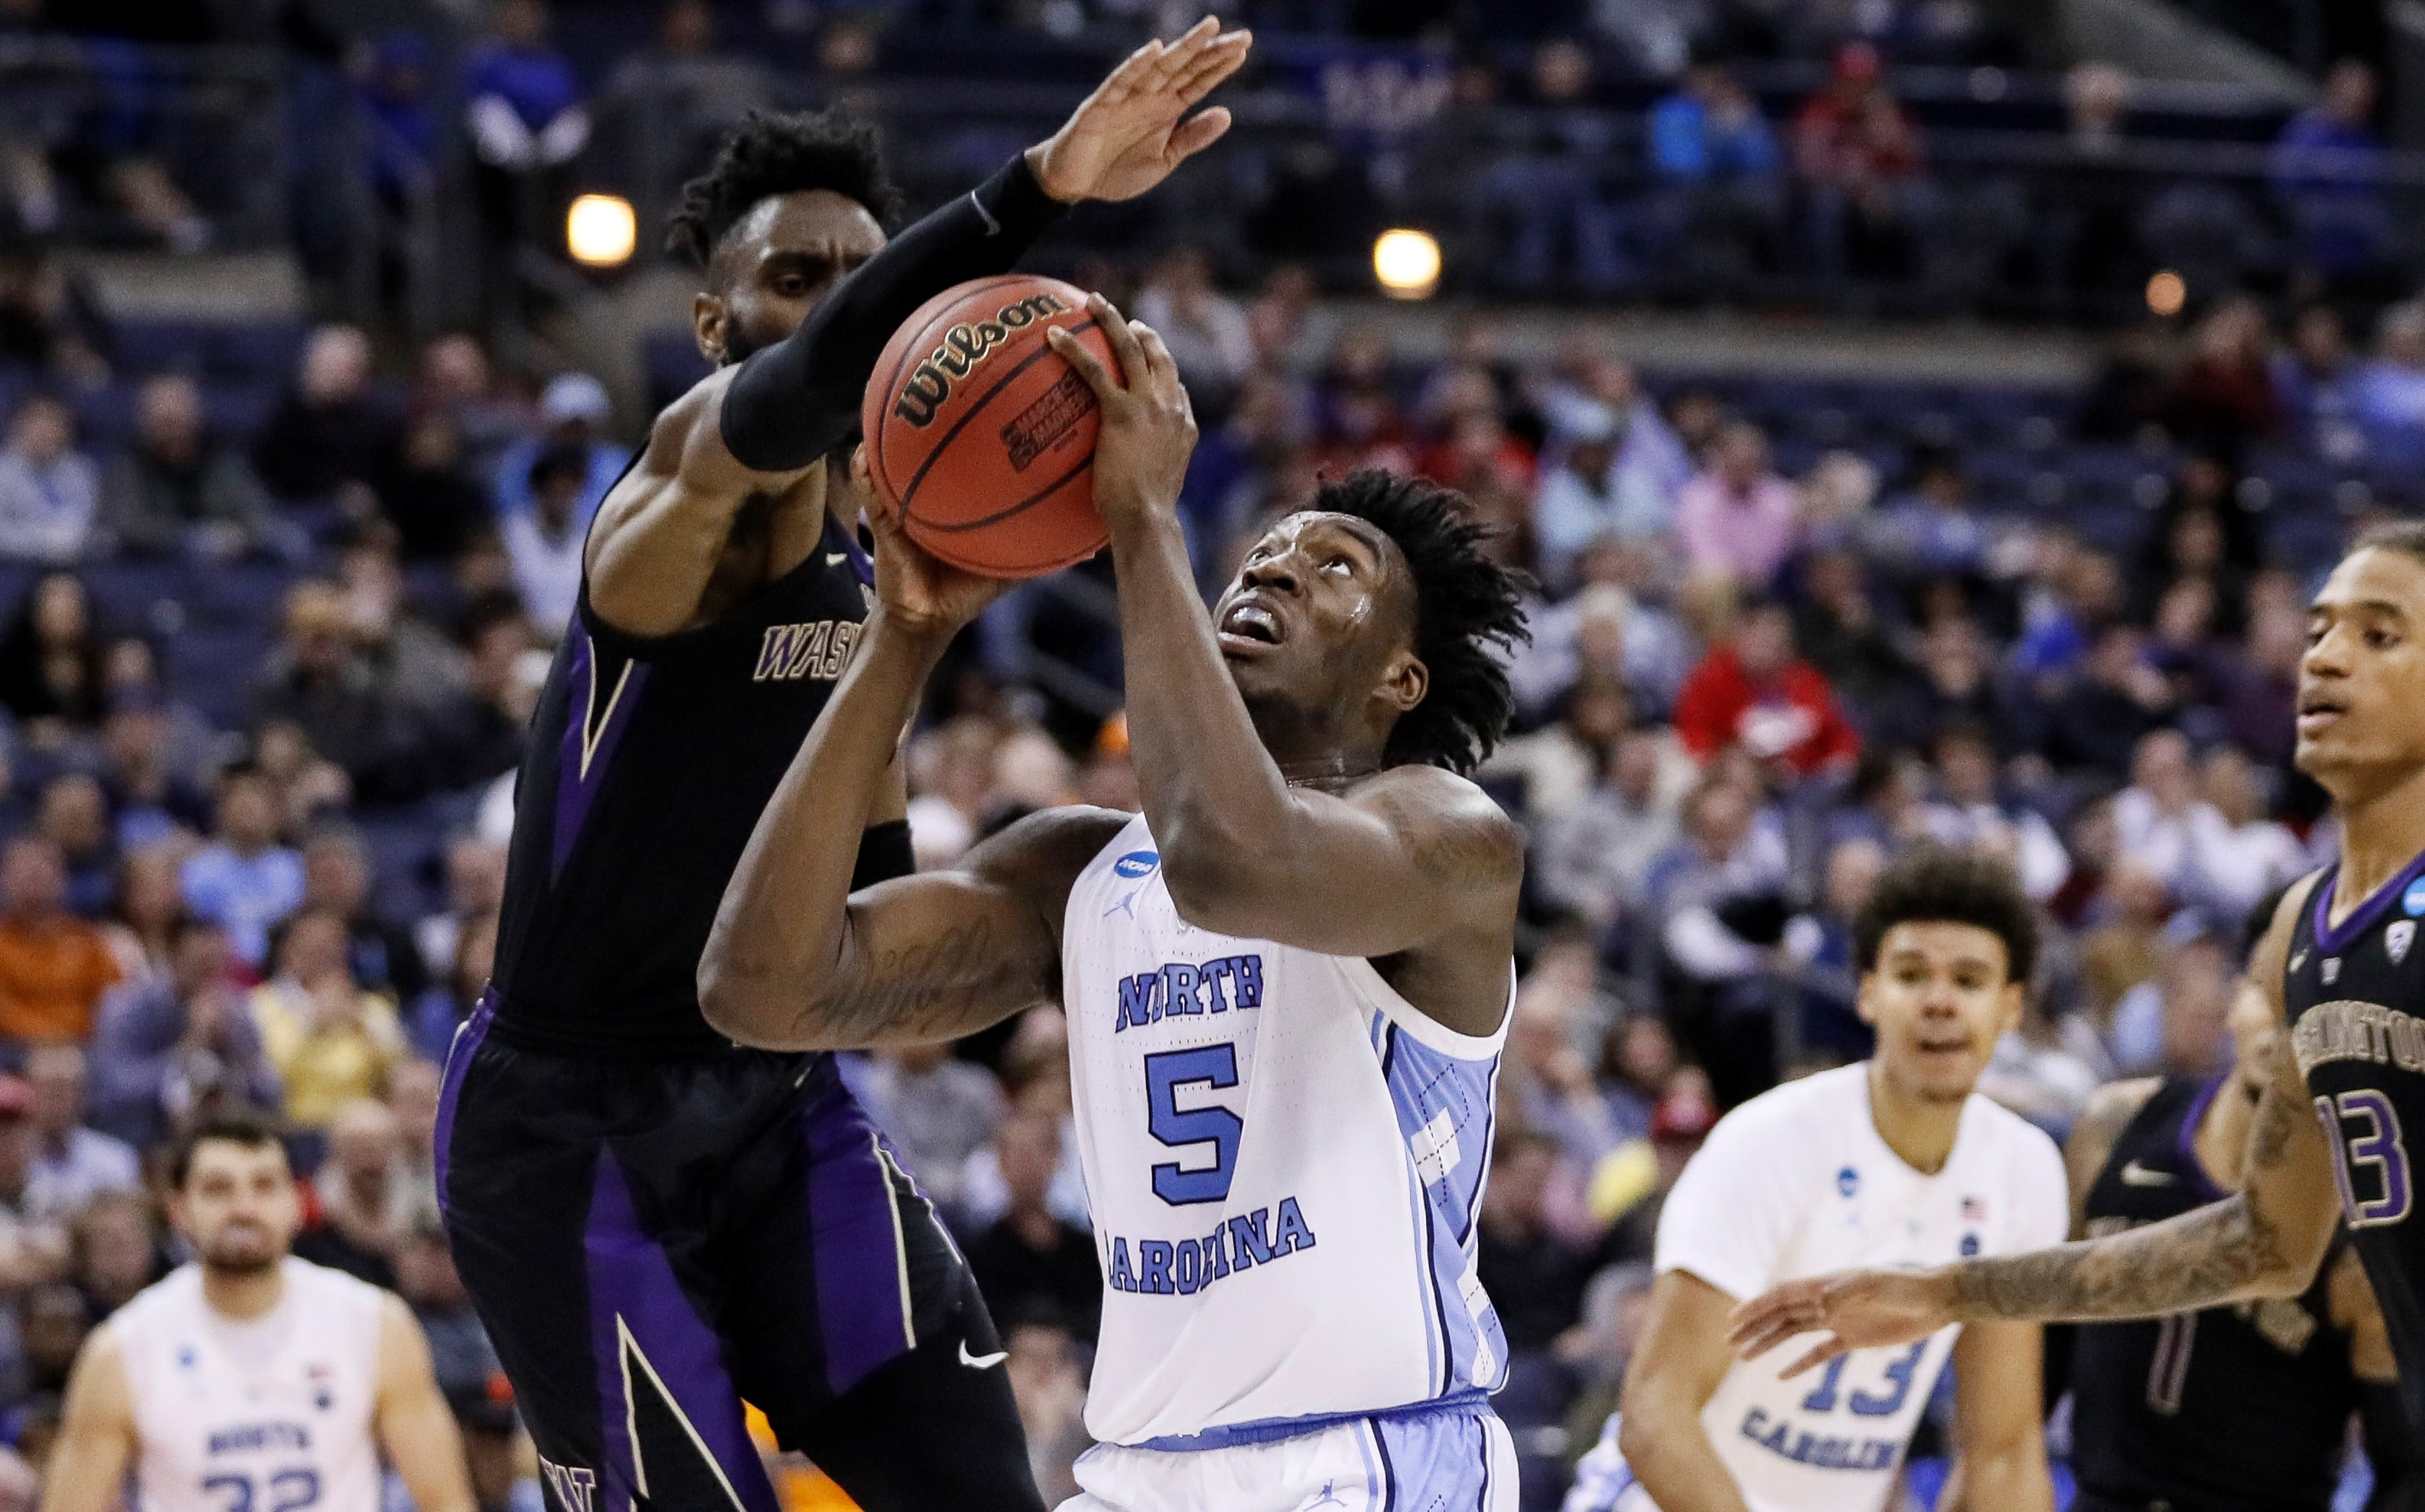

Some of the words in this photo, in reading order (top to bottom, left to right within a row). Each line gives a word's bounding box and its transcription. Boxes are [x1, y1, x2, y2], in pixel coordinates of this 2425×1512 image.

[894, 293, 1071, 429] Wilson
[1144, 1041, 1244, 1206] 5
[2314, 1088, 2413, 1229] 13
[1105, 1195, 1316, 1295] AROLINA
[1801, 1337, 1928, 1416] 13
